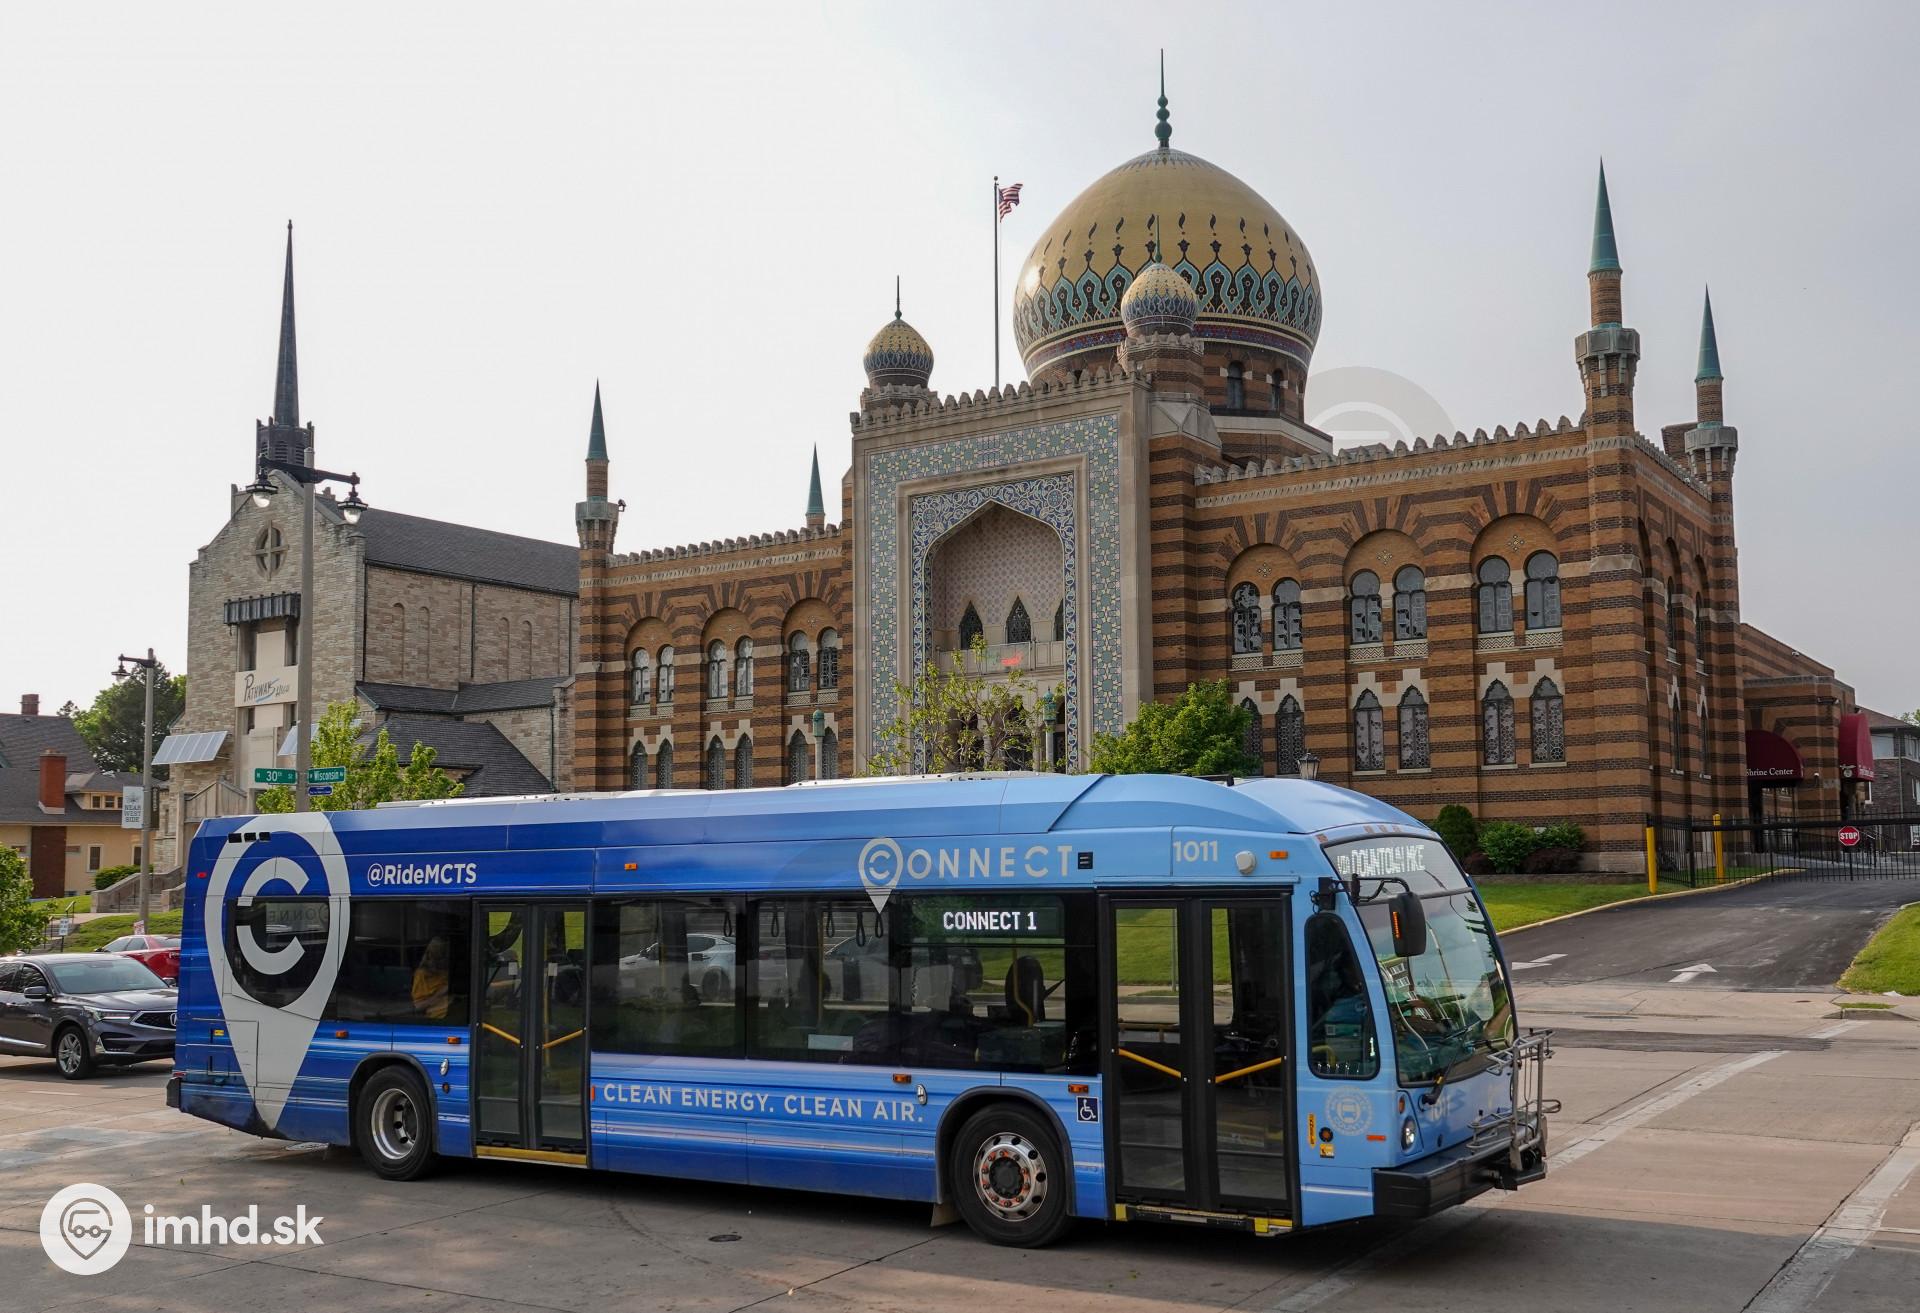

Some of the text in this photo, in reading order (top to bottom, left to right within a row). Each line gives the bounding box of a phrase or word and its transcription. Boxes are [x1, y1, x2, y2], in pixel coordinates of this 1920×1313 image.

[1769, 767, 1794, 776] Center
[1840, 832, 1858, 840] STOP
[1173, 840, 1218, 862] 1011
[367, 863, 477, 887] @RideMCTS
[943, 910, 1037, 930] CONNECT 1
[603, 1083, 925, 1122] CLEAN ENERGY. CLEAN AIR.
